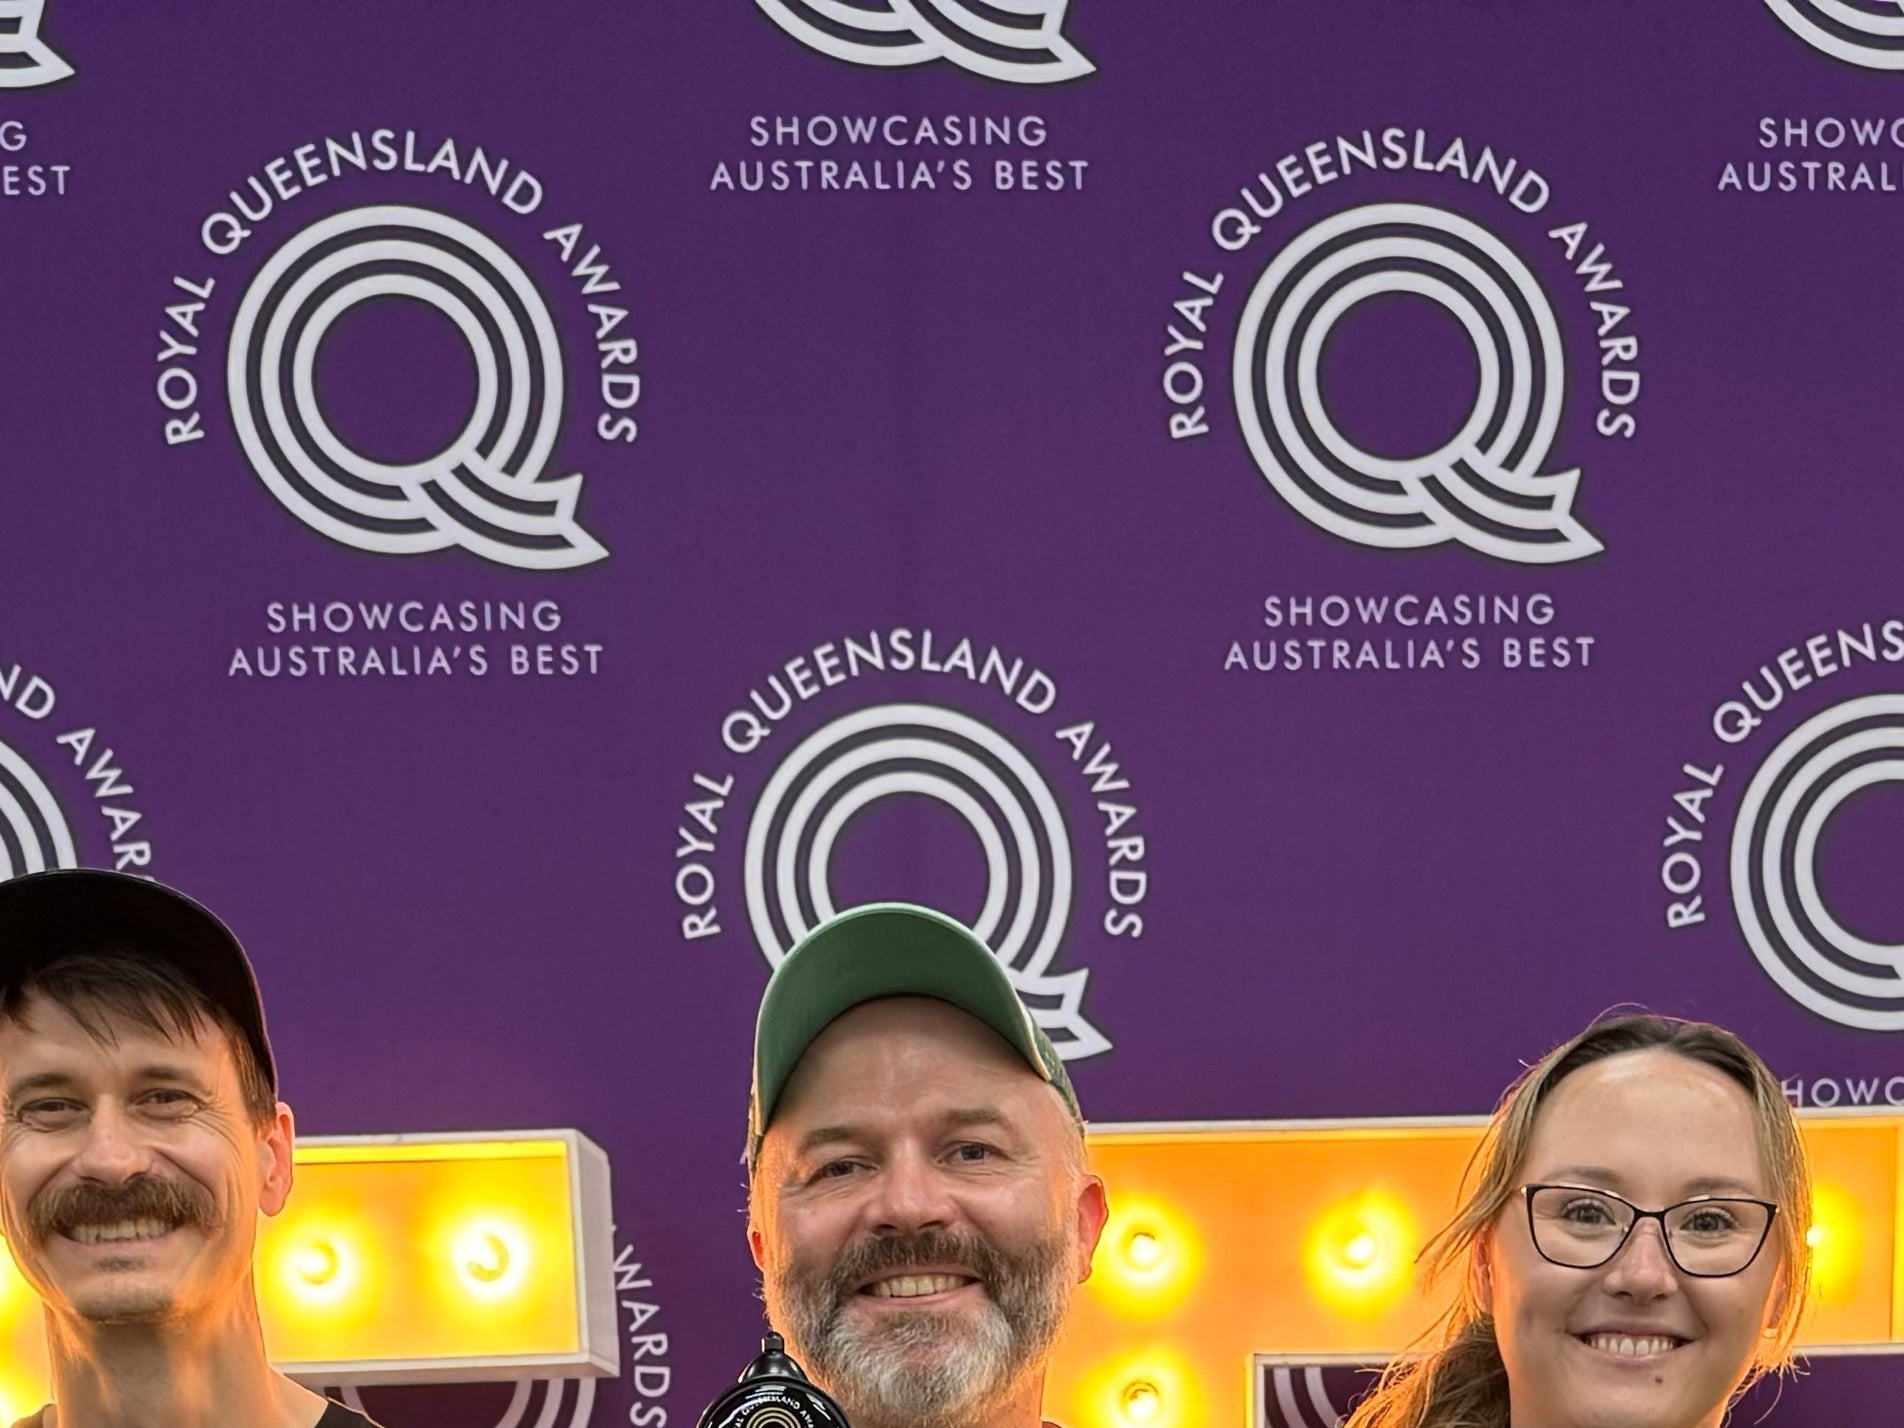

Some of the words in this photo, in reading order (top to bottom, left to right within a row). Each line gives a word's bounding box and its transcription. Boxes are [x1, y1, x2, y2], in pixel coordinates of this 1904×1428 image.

[750, 115, 1046, 147] SHOWCASING
[710, 159, 972, 191] AUSTRALIA'S
[995, 160, 1089, 191] BEST
[157, 276, 215, 445] ROYAL
[201, 129, 543, 255] QUEENSLAND
[543, 223, 640, 442] AWARDS
[1163, 271, 1224, 439] ROYAL
[1212, 127, 1549, 251] QUEENSLAND
[1548, 222, 1640, 438] AWARDS
[267, 601, 561, 633] SHOWCASING
[1265, 593, 1554, 627] SHOWCASING
[229, 644, 488, 677] AUSTRALIA'S
[511, 644, 603, 675] BEST
[1224, 637, 1480, 671] AUSTRALIA'S
[1503, 636, 1595, 668] BEST
[675, 774, 734, 939] ROYAL
[722, 628, 1056, 753] QUEENSLAND
[1055, 722, 1147, 938] AWARDS
[56, 728, 155, 881] AWAR
[1662, 764, 1724, 928] ROYAL
